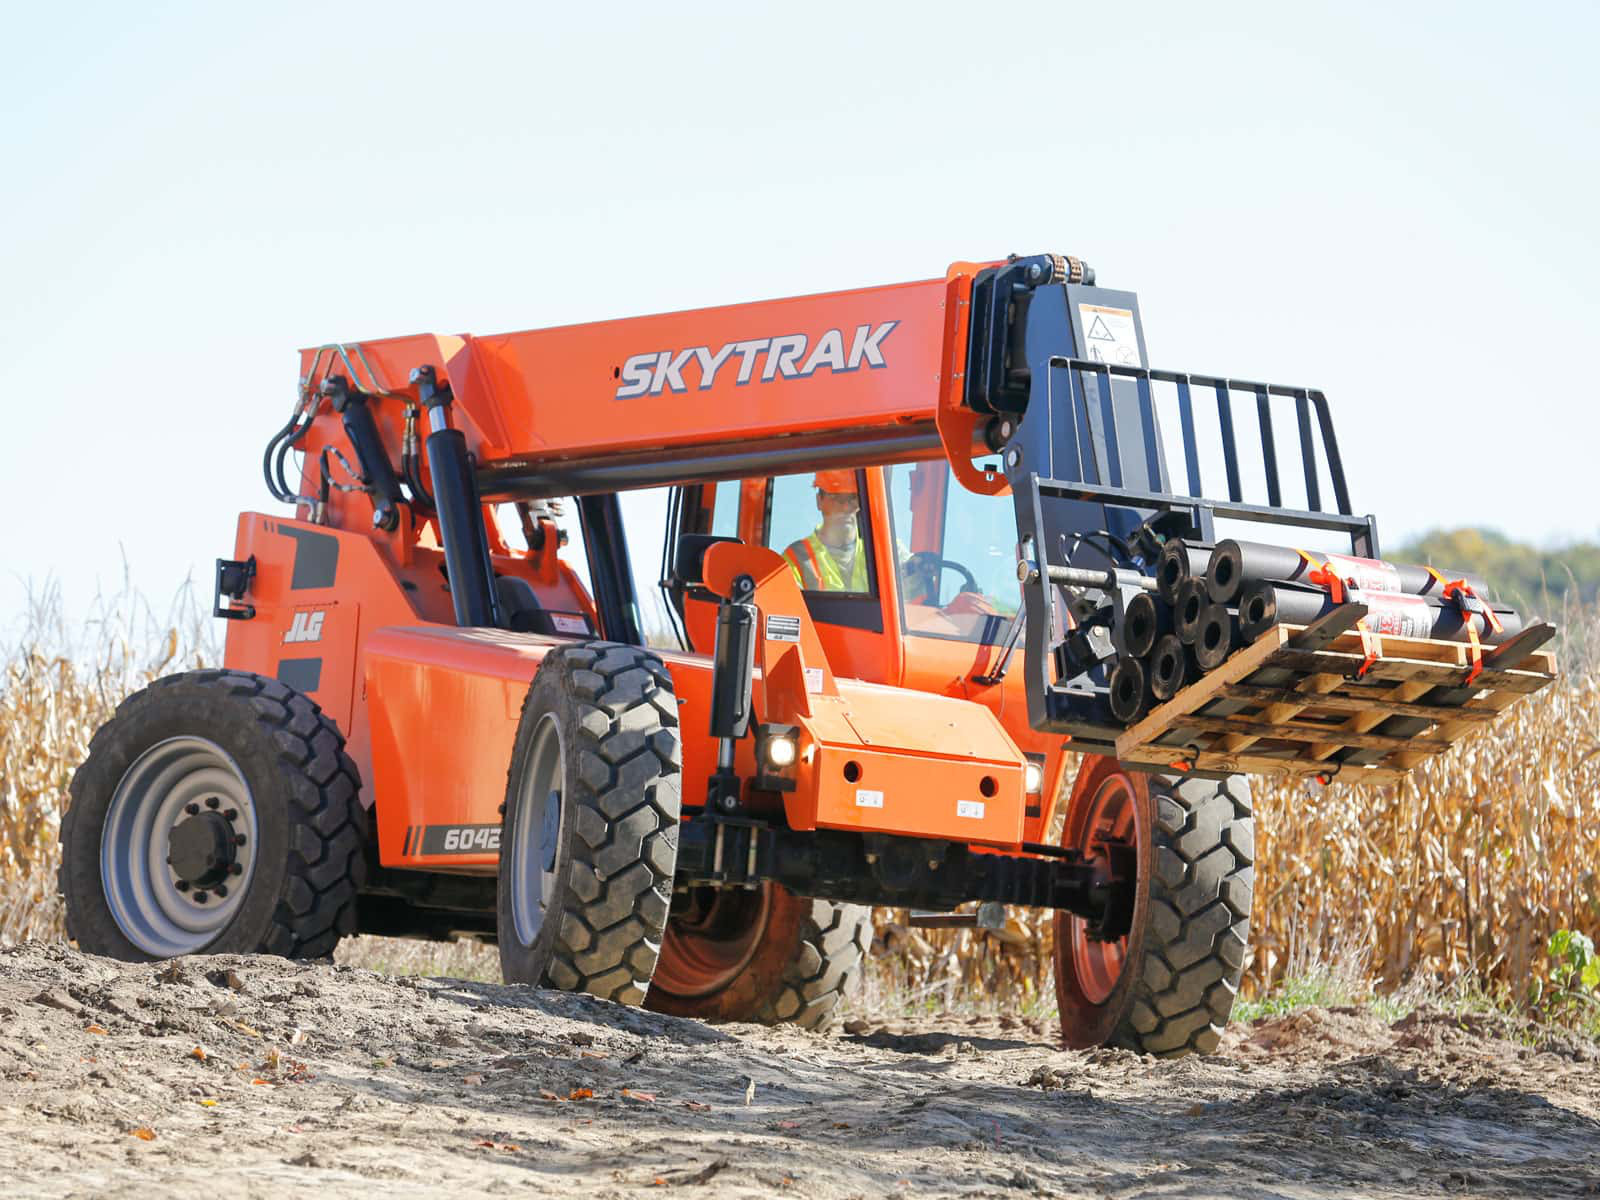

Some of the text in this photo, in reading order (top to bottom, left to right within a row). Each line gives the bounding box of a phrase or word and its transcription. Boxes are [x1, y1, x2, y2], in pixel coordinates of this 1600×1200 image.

[615, 320, 901, 400] SKYTRAK
[283, 611, 325, 643] JLG
[444, 827, 502, 851] 6042
